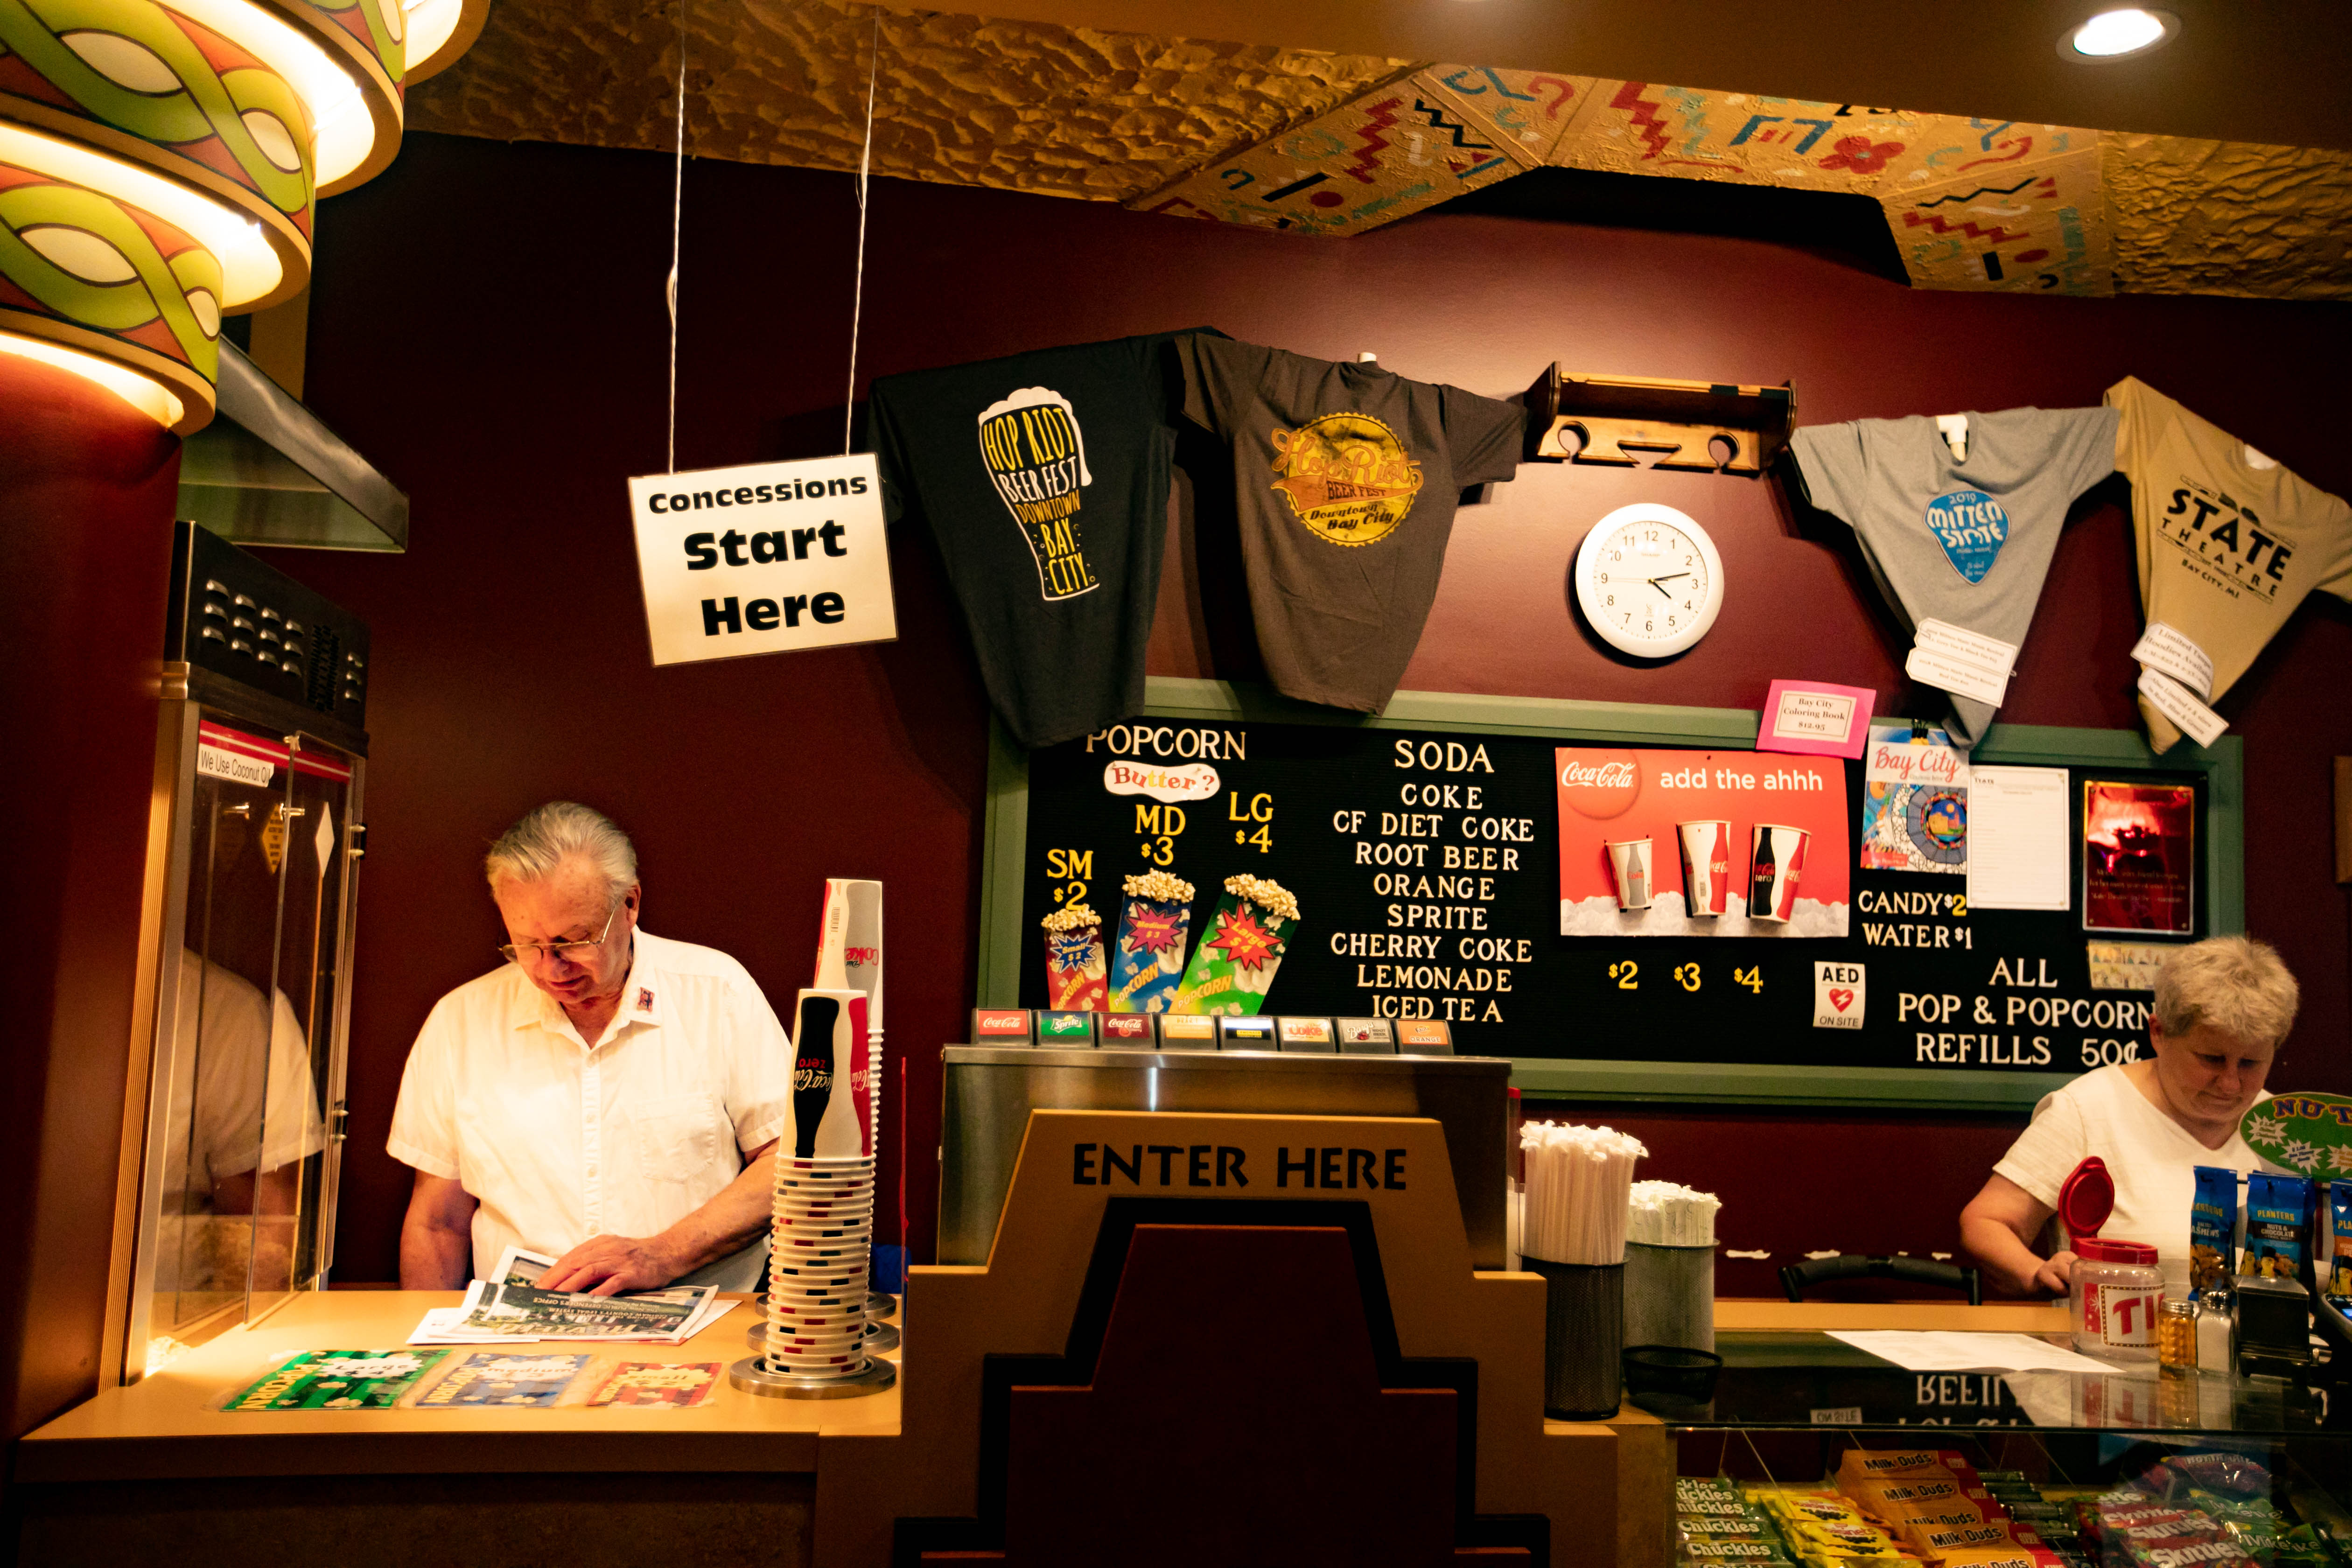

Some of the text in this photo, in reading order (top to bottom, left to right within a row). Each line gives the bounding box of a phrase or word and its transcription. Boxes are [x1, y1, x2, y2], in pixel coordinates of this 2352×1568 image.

[984, 407, 1074, 471] HOP RIOT
[1271, 428, 1421, 489] Hop Riot
[998, 456, 1077, 503] BEER FEST
[1327, 480, 1386, 500] BEER FEST
[649, 476, 868, 514] Concessions
[1015, 490, 1081, 524] DOWNTOWN
[1310, 504, 1378, 520] Downtown
[1327, 511, 1394, 530] Bay City
[1926, 501, 2002, 529] MITTEN
[684, 519, 847, 570] Start
[1041, 518, 1075, 558] BAY
[1623, 535, 1635, 546] 11
[1644, 531, 1658, 541] 12
[1670, 539, 1675, 549] 1
[1940, 522, 2003, 547] STATE
[2167, 489, 2292, 581] STATE
[1686, 555, 1692, 566] 2
[2162, 517, 2278, 596] THEATRE
[1048, 552, 1088, 595] CITY
[1601, 573, 1608, 583] 9
[1692, 579, 1699, 589] 3
[2182, 559, 2199, 574] BAY
[2226, 586, 2240, 599] MI
[701, 591, 845, 637] Here
[1607, 595, 1614, 606] 8
[1684, 600, 1691, 610] 4
[1624, 613, 1631, 623] 7
[1646, 621, 1652, 631] 6
[1668, 616, 1675, 626] 5
[1783, 708, 1845, 721] Coloring Book
[1799, 698, 1834, 709] Bay City
[1799, 721, 1826, 731] $12.95
[1085, 725, 1246, 760] POPCORN
[1395, 739, 1495, 773] SODA
[202, 750, 213, 769] We
[216, 754, 230, 774] Use
[233, 759, 259, 780] Coconut
[1561, 761, 1636, 788] Coca-Cola
[1875, 746, 1960, 783] Bay City
[1660, 767, 1823, 791] add the ahhh
[1229, 791, 1274, 822] LG
[1401, 783, 1483, 809] COKE
[1135, 805, 1185, 836] MD
[1333, 810, 1534, 842] CF DIET COKE
[1141, 837, 1174, 866] $3
[1235, 824, 1273, 854] $4
[1046, 849, 1093, 880] SM
[1356, 842, 1519, 871] ROOT BEER
[1053, 882, 1087, 911] $2
[1373, 873, 1496, 901] ORANGE
[1858, 890, 1943, 916] CANDY
[1136, 921, 1170, 930] Medium
[1387, 904, 1488, 931] SPRITE
[1062, 943, 1085, 953] Small
[1232, 922, 1266, 948] Large
[1331, 932, 1533, 962] CHERRY COKE
[1862, 923, 1973, 949] WATER $1
[1114, 962, 1159, 1008] POPCORN
[1357, 964, 1512, 992] LEMONADE
[1609, 960, 1638, 990] $2
[1673, 962, 1701, 992] $3
[1734, 965, 1764, 994] $4
[1822, 966, 1859, 984] AED
[1988, 958, 2058, 988] ALL
[1178, 975, 1232, 1010] POPCORN
[1372, 995, 1504, 1022] ICED TEA
[1820, 1016, 1859, 1027] ON SITE
[1899, 993, 2156, 1030] POP & POPCORN
[983, 1017, 1021, 1028] Coca-Cola
[1054, 1018, 1078, 1030] Sprite
[1108, 1019, 1142, 1029] Coca-Cola
[1916, 1033, 2051, 1065] REFILLS
[798, 1057, 826, 1069] zero
[1073, 1143, 1407, 1190] ENTER HERE
[2257, 1210, 2294, 1222] PLANTERS
[2261, 1228, 2295, 1237] CHOCOLATE
[236, 1364, 322, 1409] POPCORN
[1863, 1458, 1895, 1470] Milk
[1897, 1453, 1932, 1466] Duds
[1883, 1487, 1916, 1501] Milk
[1917, 1484, 1953, 1496] Duds
[1939, 1513, 1976, 1525] Duds
[2128, 1519, 2218, 1539] Skittles
[1930, 1527, 2003, 1548] Milk Duds
[2150, 1542, 2248, 1568] Skittles
